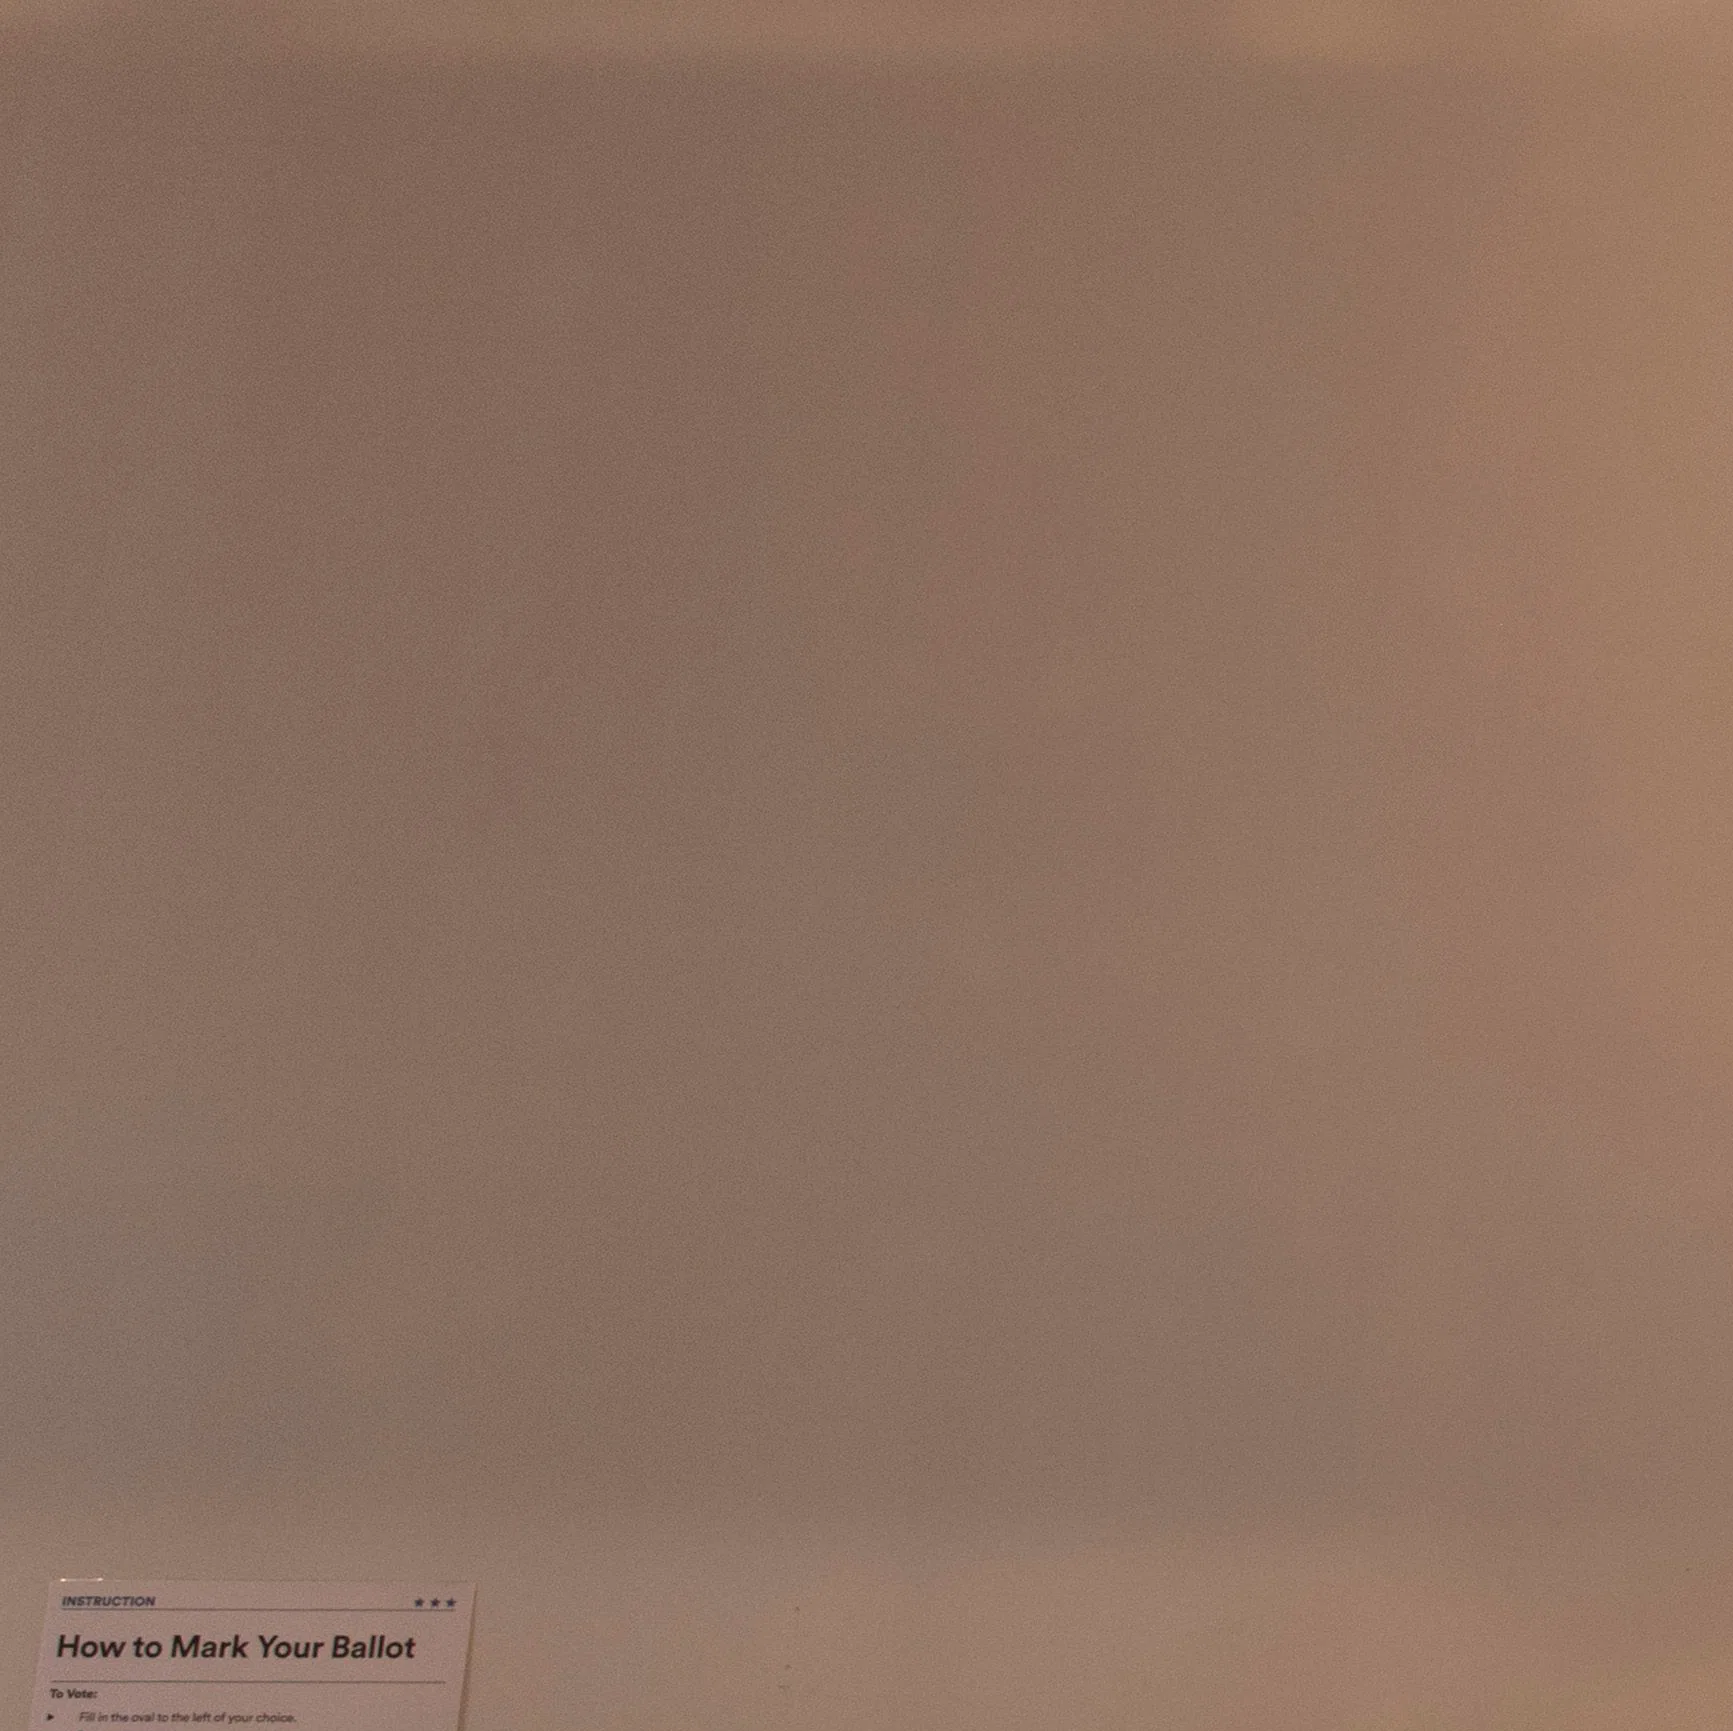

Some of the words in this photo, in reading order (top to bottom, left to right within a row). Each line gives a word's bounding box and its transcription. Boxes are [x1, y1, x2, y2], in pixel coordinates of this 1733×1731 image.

[62, 1596, 155, 1607] INSTRUCTION
[57, 1636, 124, 1659] How
[134, 1637, 162, 1659] to
[172, 1636, 248, 1659] Mark
[260, 1636, 324, 1659] Your
[332, 1636, 416, 1659] Ballot
[50, 1689, 63, 1698] To
[68, 1689, 97, 1698] Vote:
[80, 1713, 94, 1722] Fill
[98, 1713, 107, 1722] in
[111, 1713, 128, 1722] the
[131, 1713, 154, 1722] oval
[158, 1713, 169, 1722] to
[173, 1713, 189, 1722] the
[193, 1713, 212, 1722] left
[215, 1713, 226, 1722] of
[228, 1715, 253, 1725] your
[257, 1713, 296, 1722] choice.
